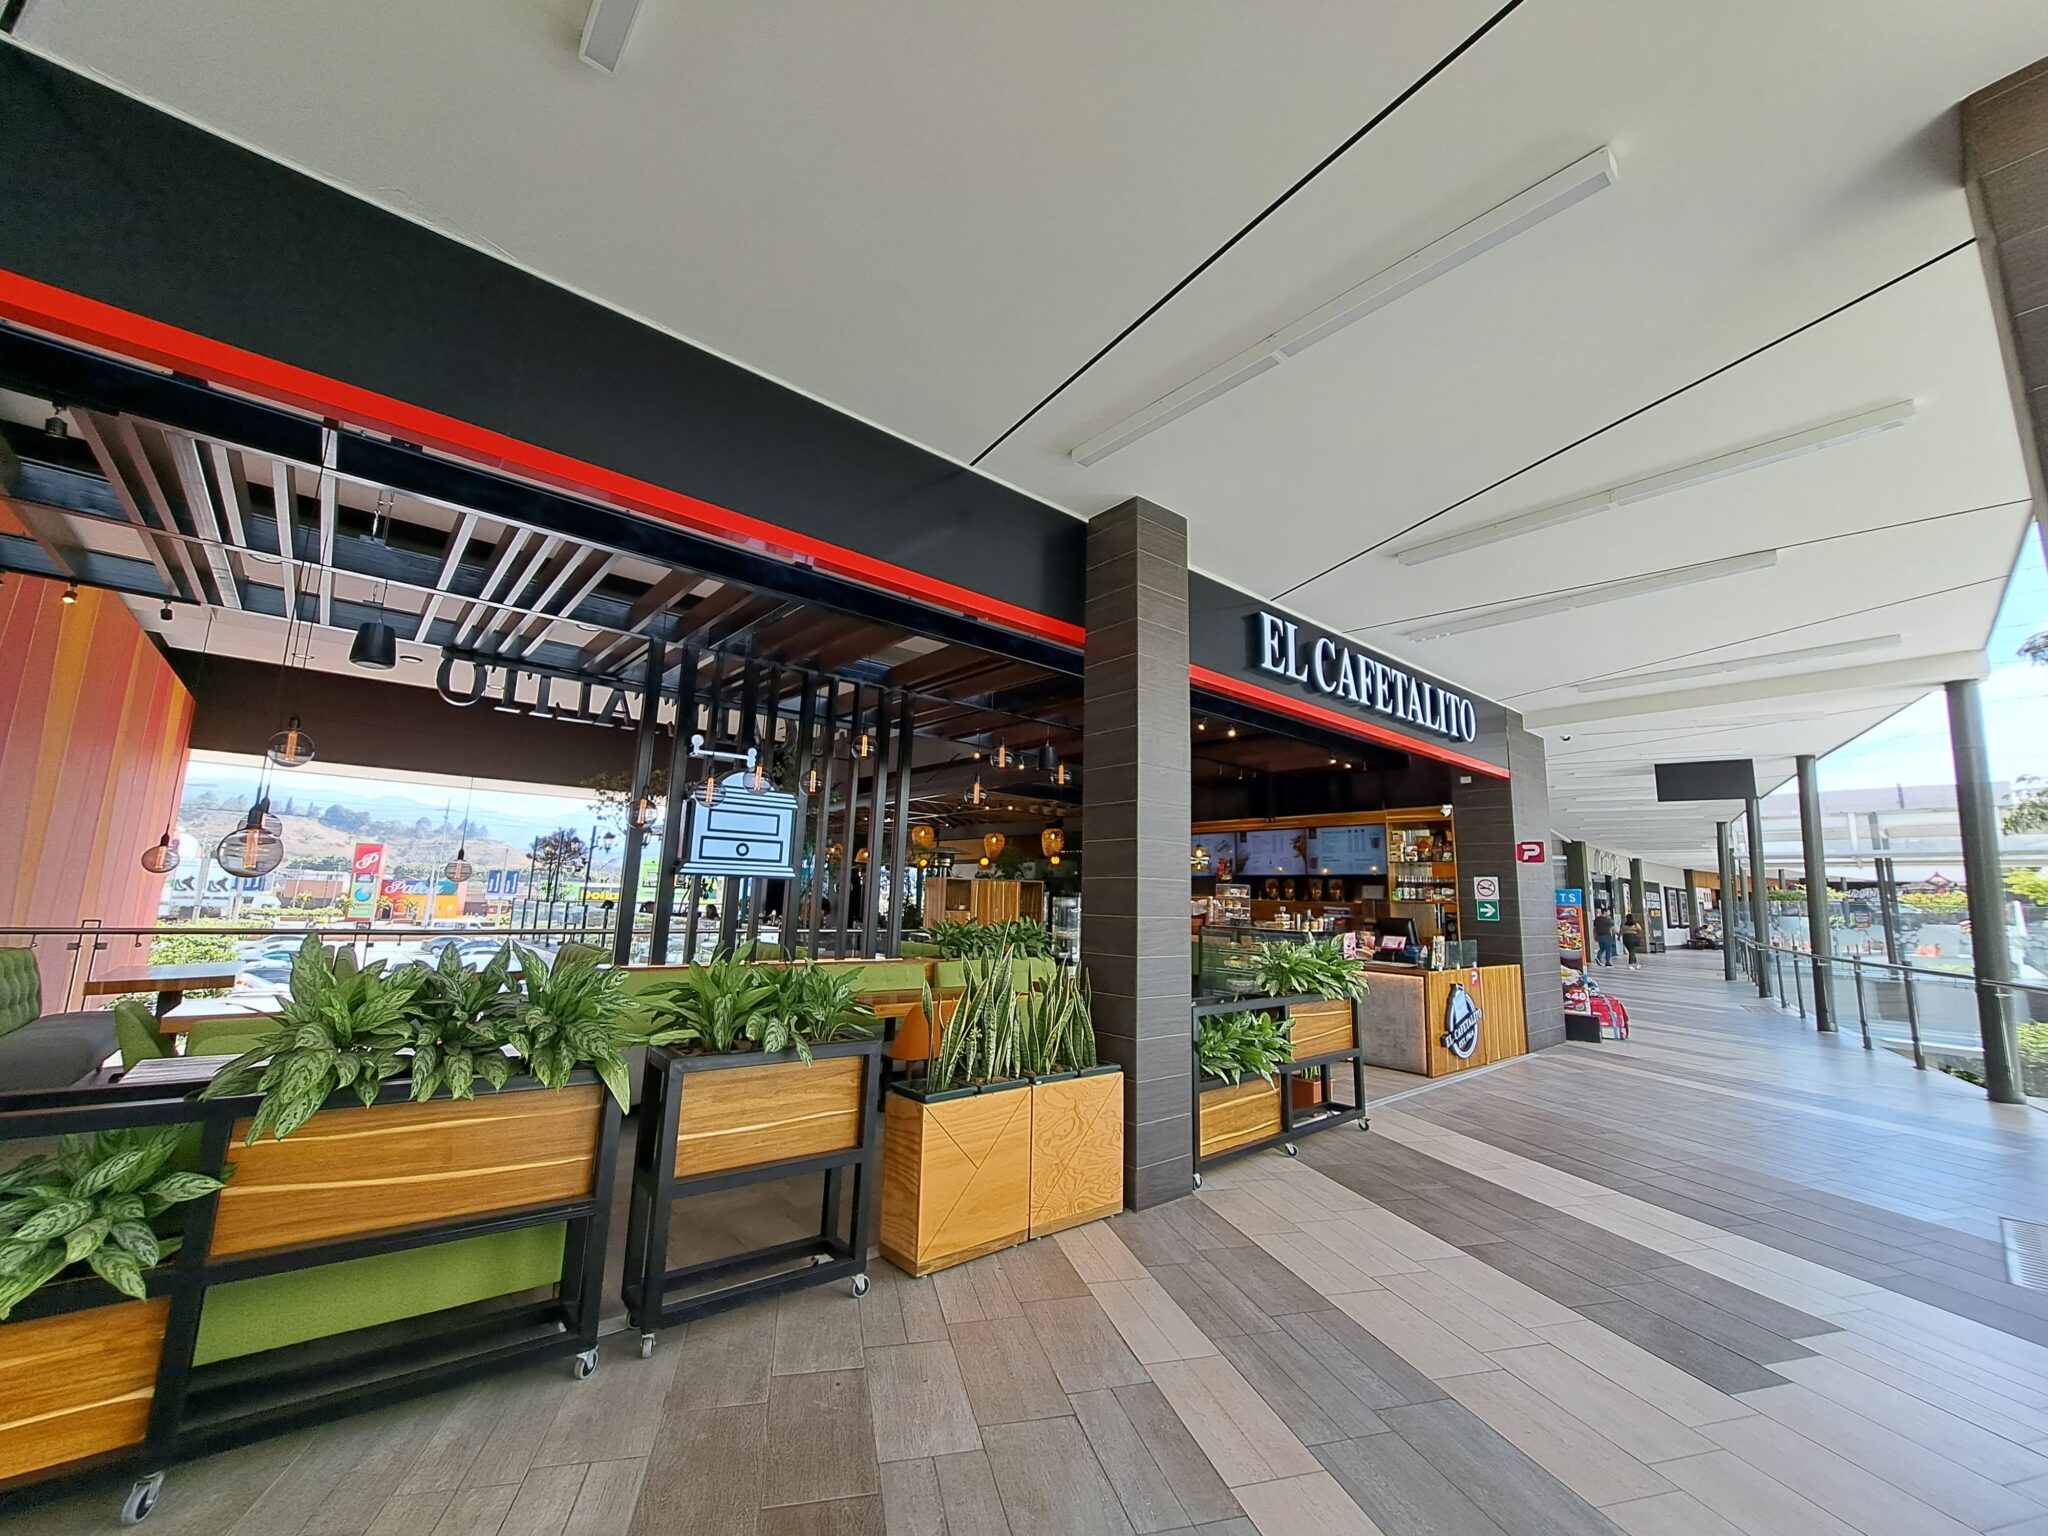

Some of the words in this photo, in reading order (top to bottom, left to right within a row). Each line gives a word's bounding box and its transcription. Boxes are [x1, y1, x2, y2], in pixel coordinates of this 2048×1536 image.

[1260, 611, 1309, 683] EL
[1313, 637, 1477, 744] CAFETALITO
[1454, 1008, 1482, 1040] CAFETALITO
